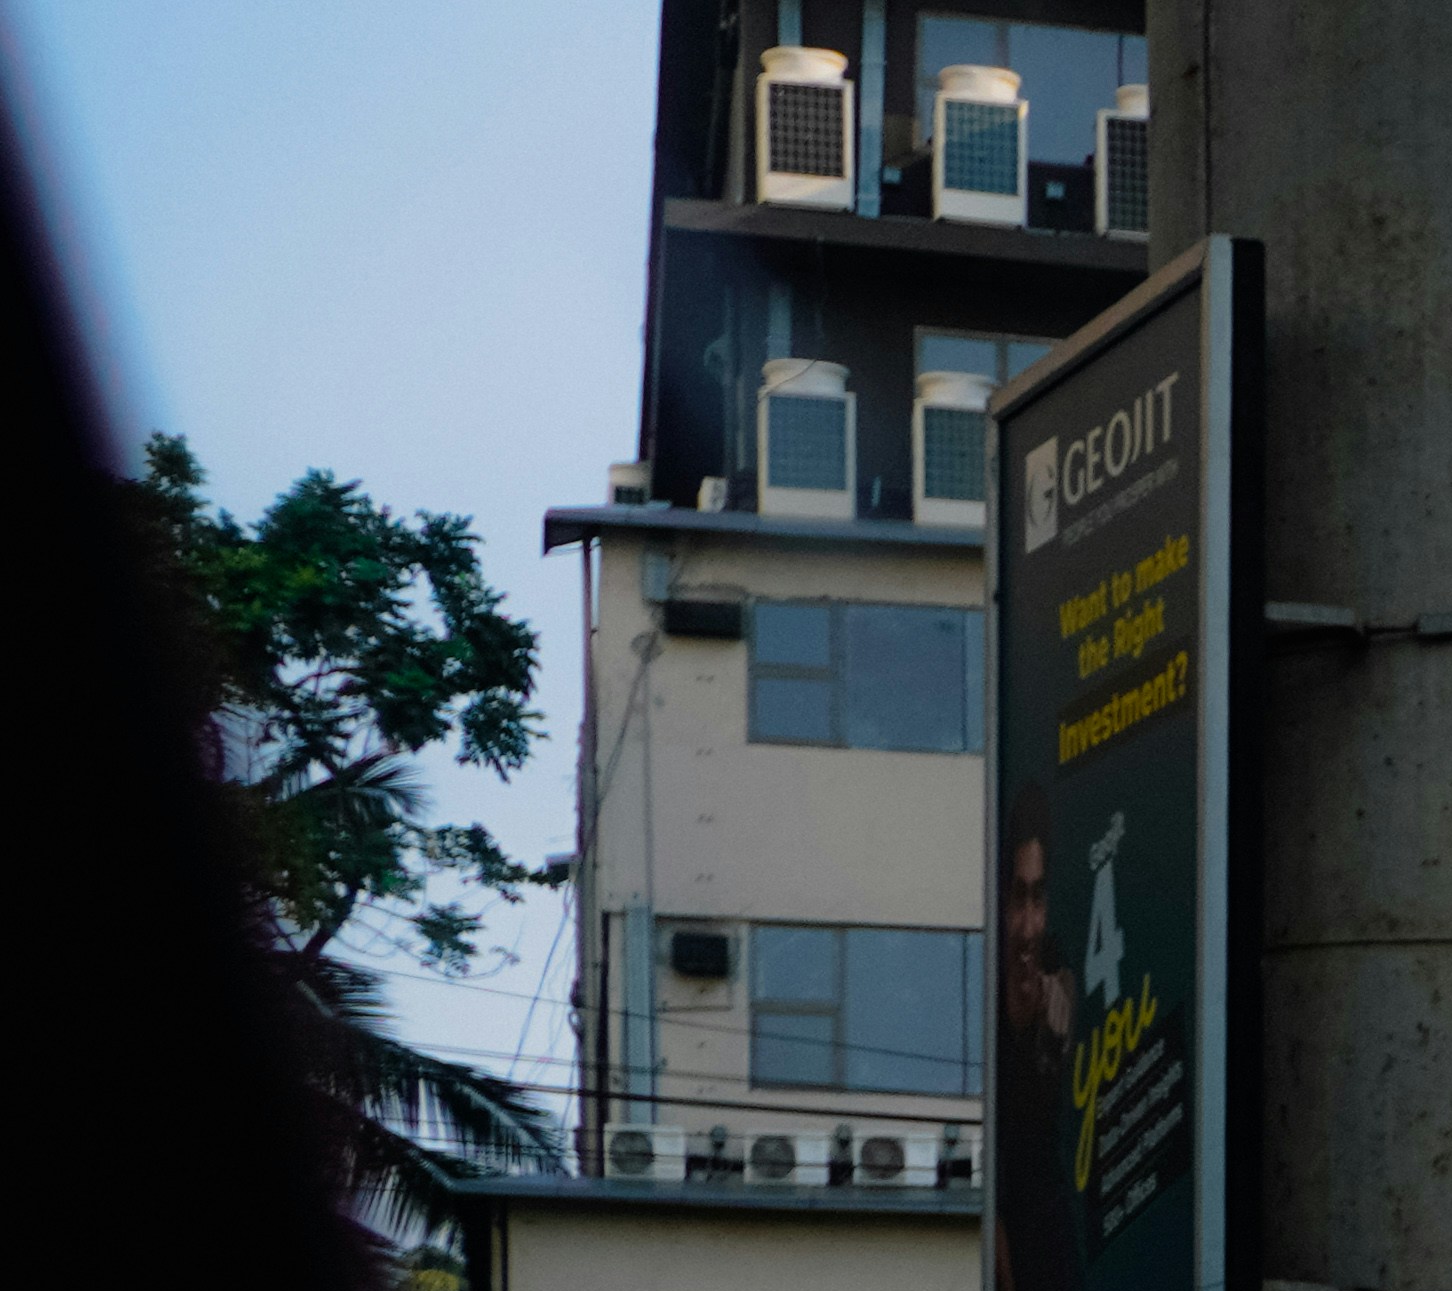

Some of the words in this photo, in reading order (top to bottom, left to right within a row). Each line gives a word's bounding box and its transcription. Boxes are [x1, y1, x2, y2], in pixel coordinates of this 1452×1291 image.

[1063, 372, 1181, 506] GEOJIT
[1058, 579, 1108, 641] Want
[1111, 570, 1133, 610] to
[1135, 533, 1191, 595] make
[1077, 634, 1110, 681] the
[1113, 595, 1166, 661] Right
[1058, 649, 1189, 766] Investment?
[1084, 856, 1127, 1010] 4
[1072, 971, 1159, 1193] you
